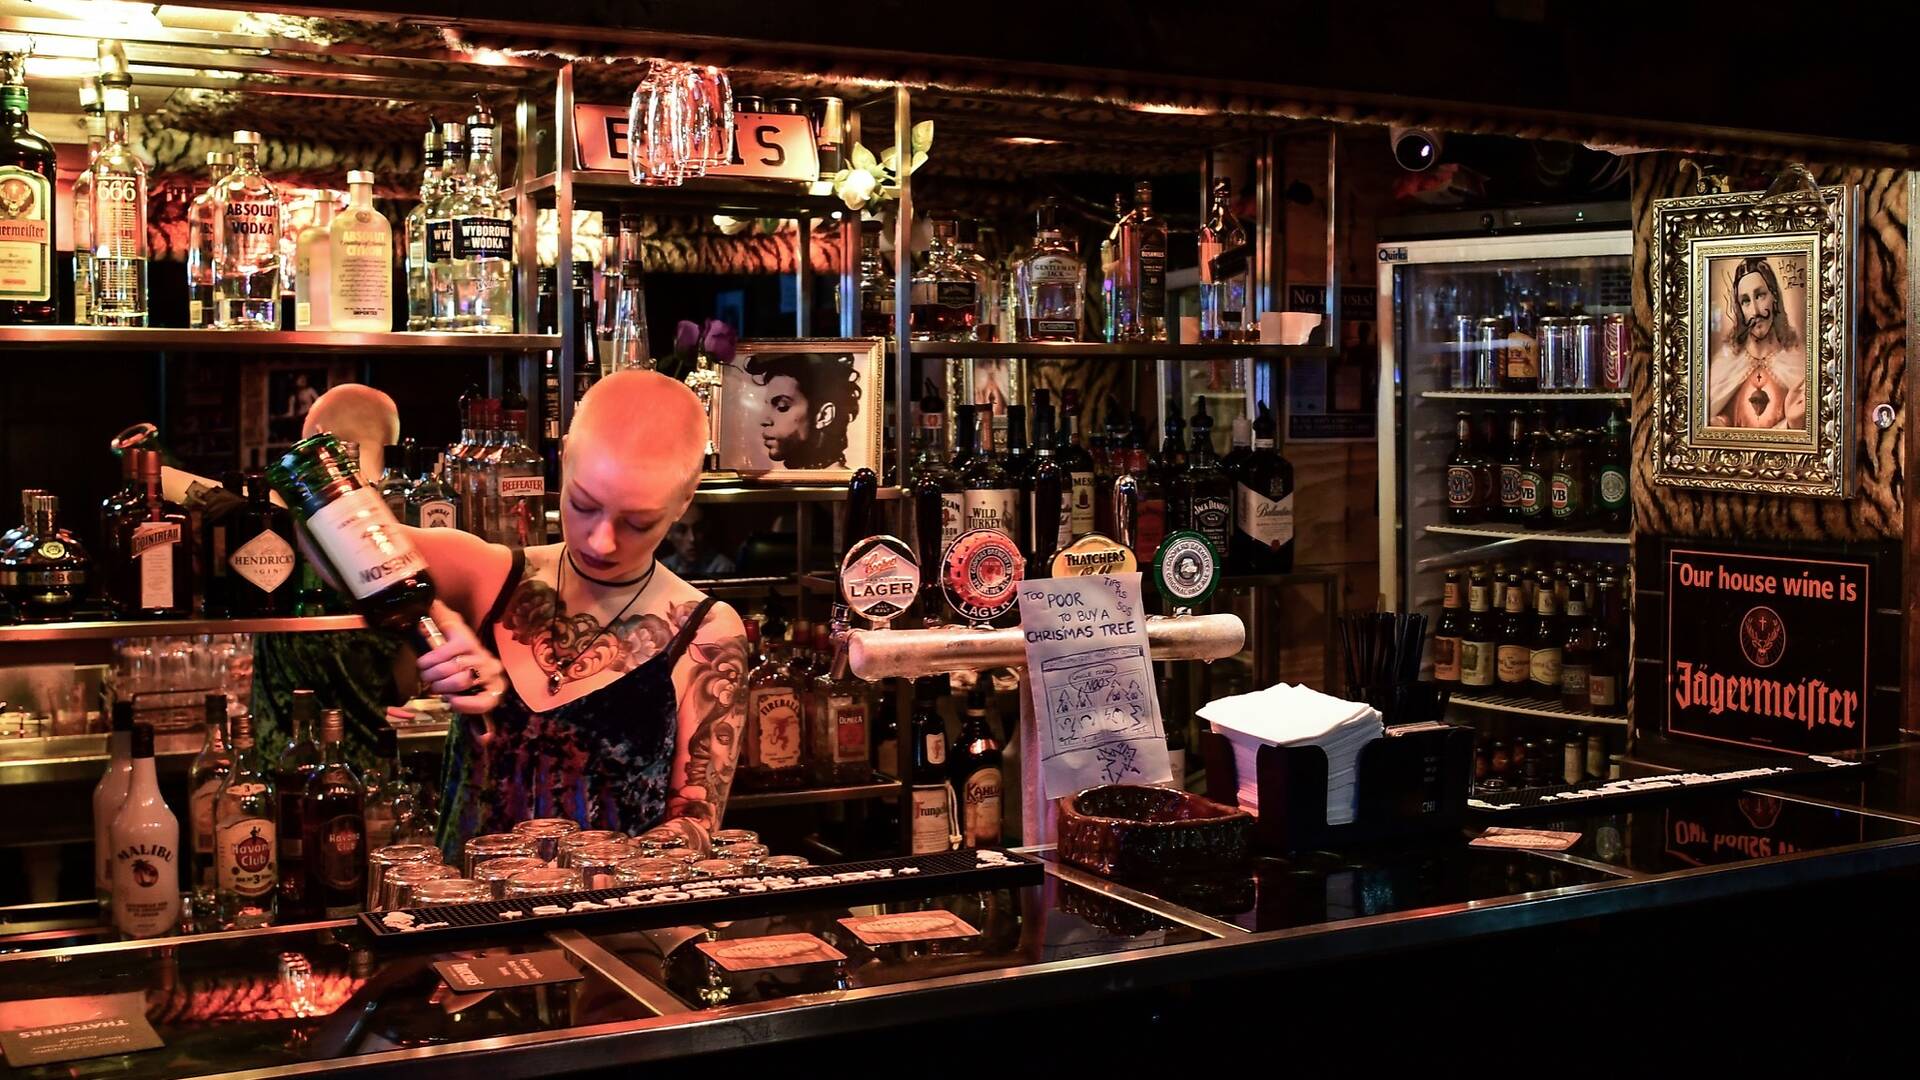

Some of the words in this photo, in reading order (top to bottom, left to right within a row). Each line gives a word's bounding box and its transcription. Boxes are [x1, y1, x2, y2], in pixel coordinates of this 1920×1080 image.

[97, 180, 136, 201] 666
[226, 203, 278, 217] ABSOLUT
[232, 222, 274, 236] VODKA
[343, 231, 385, 241] ABSOLUT
[1292, 288, 1316, 306] No
[502, 480, 544, 492] BEEFEATER
[972, 507, 997, 518] WILD
[967, 516, 1001, 529] TURKEY
[135, 528, 178, 552] COINTREAU
[1065, 549, 1126, 566] THATCHERS
[1166, 543, 1190, 566] COOPERS
[850, 582, 914, 597] LAGER
[1166, 572, 1188, 595] ORIGINAL
[1679, 563, 1714, 589] Our
[1718, 565, 1777, 595] house
[1782, 571, 1834, 600] wine
[1838, 575, 1858, 602] is
[1024, 591, 1045, 602] TOO
[1047, 592, 1084, 608] POOR
[1058, 612, 1072, 623] TO
[1077, 608, 1098, 622] BUY
[1101, 610, 1110, 620] A
[1099, 621, 1137, 637] TREE
[760, 698, 800, 716] FIREBALL
[117, 844, 173, 863] MALIBU
[240, 855, 267, 866] Club
[531, 885, 732, 915] SAILOR
[737, 866, 895, 894] JERRY
[18, 1018, 130, 1040] THATCHERS
